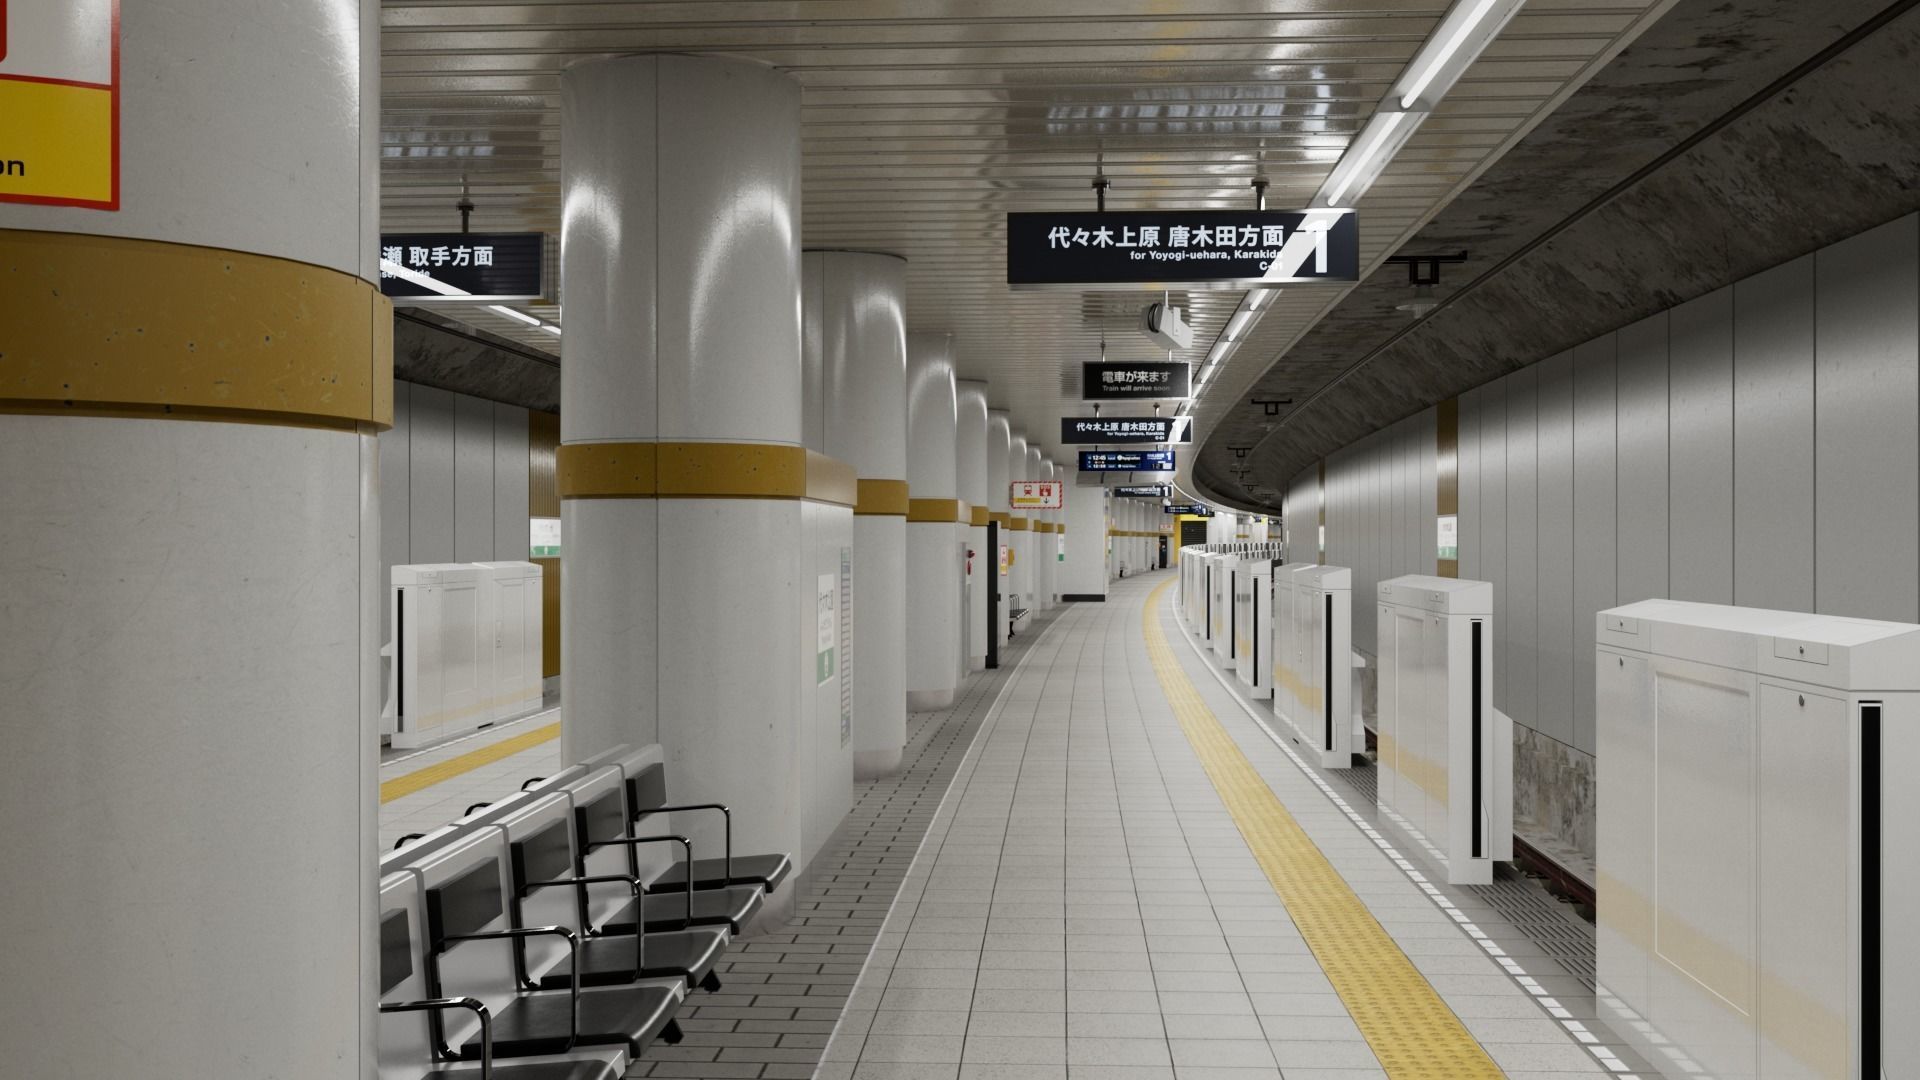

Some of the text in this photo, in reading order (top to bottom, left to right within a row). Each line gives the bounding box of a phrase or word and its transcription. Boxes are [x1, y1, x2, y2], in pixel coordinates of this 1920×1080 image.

[1048, 224, 1284, 249] 代々木上原 唐木田方面
[1305, 220, 1327, 273] 1
[409, 245, 494, 267] 取手方面
[1130, 250, 1146, 260] for
[1149, 250, 1231, 262] Yoyogi-uehara,
[1259, 262, 1283, 271] C-01
[1102, 371, 1172, 383] 電車が来ます
[1076, 422, 1165, 431] 代々木上原 唐木田方面
